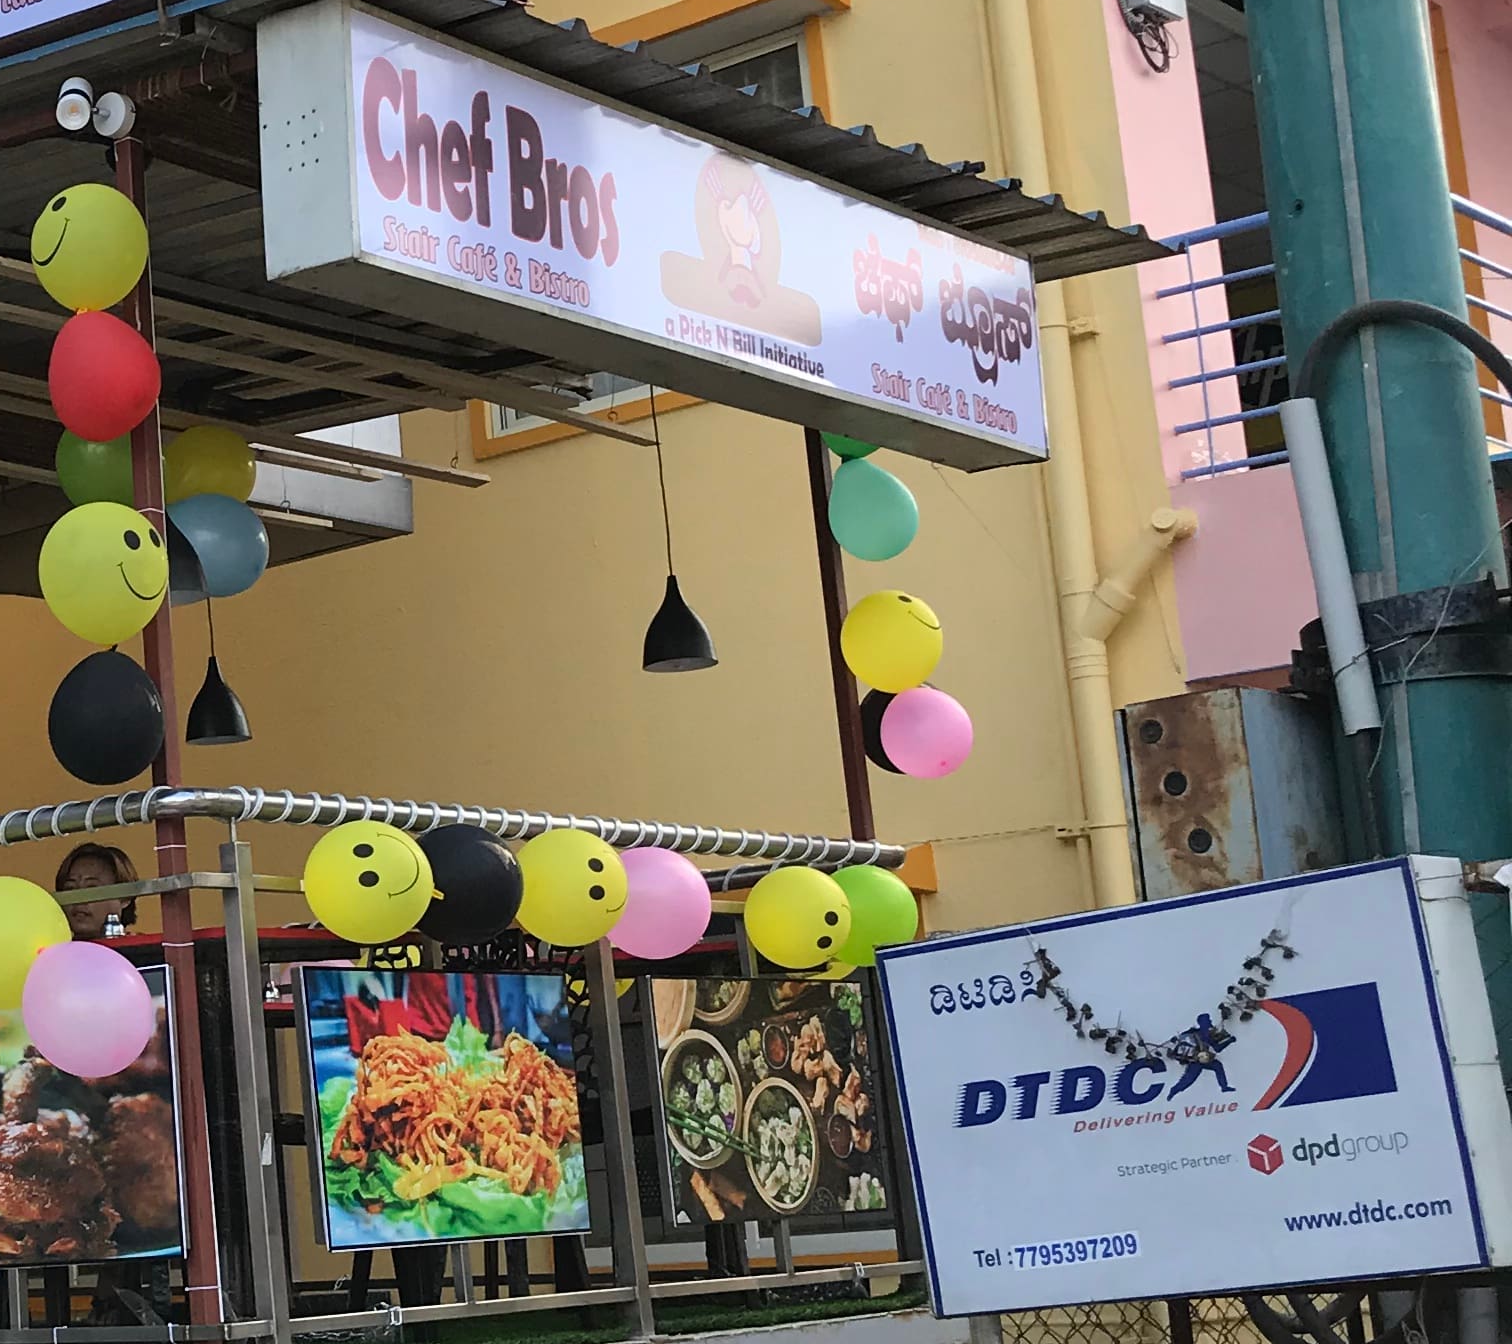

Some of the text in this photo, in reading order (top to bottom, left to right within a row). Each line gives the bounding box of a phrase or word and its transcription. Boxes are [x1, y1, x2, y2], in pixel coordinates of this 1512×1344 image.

[362, 56, 620, 267] Chef Bros
[383, 215, 590, 308] Stair Café & Bistro
[678, 314, 712, 347] Pick
[715, 324, 728, 351] N
[732, 329, 756, 356] Bill
[760, 337, 825, 379] Initiative
[871, 362, 1017, 434] Stair Café & Bistro
[953, 1057, 1170, 1128] DTDC
[1073, 1099, 1240, 1135] Delivering Value
[1117, 1152, 1232, 1178] Strategic Partner
[1292, 1129, 1409, 1167] dpdgroup
[1285, 1196, 1453, 1233] www.dtdc.com
[974, 1248, 1002, 1269] Tel
